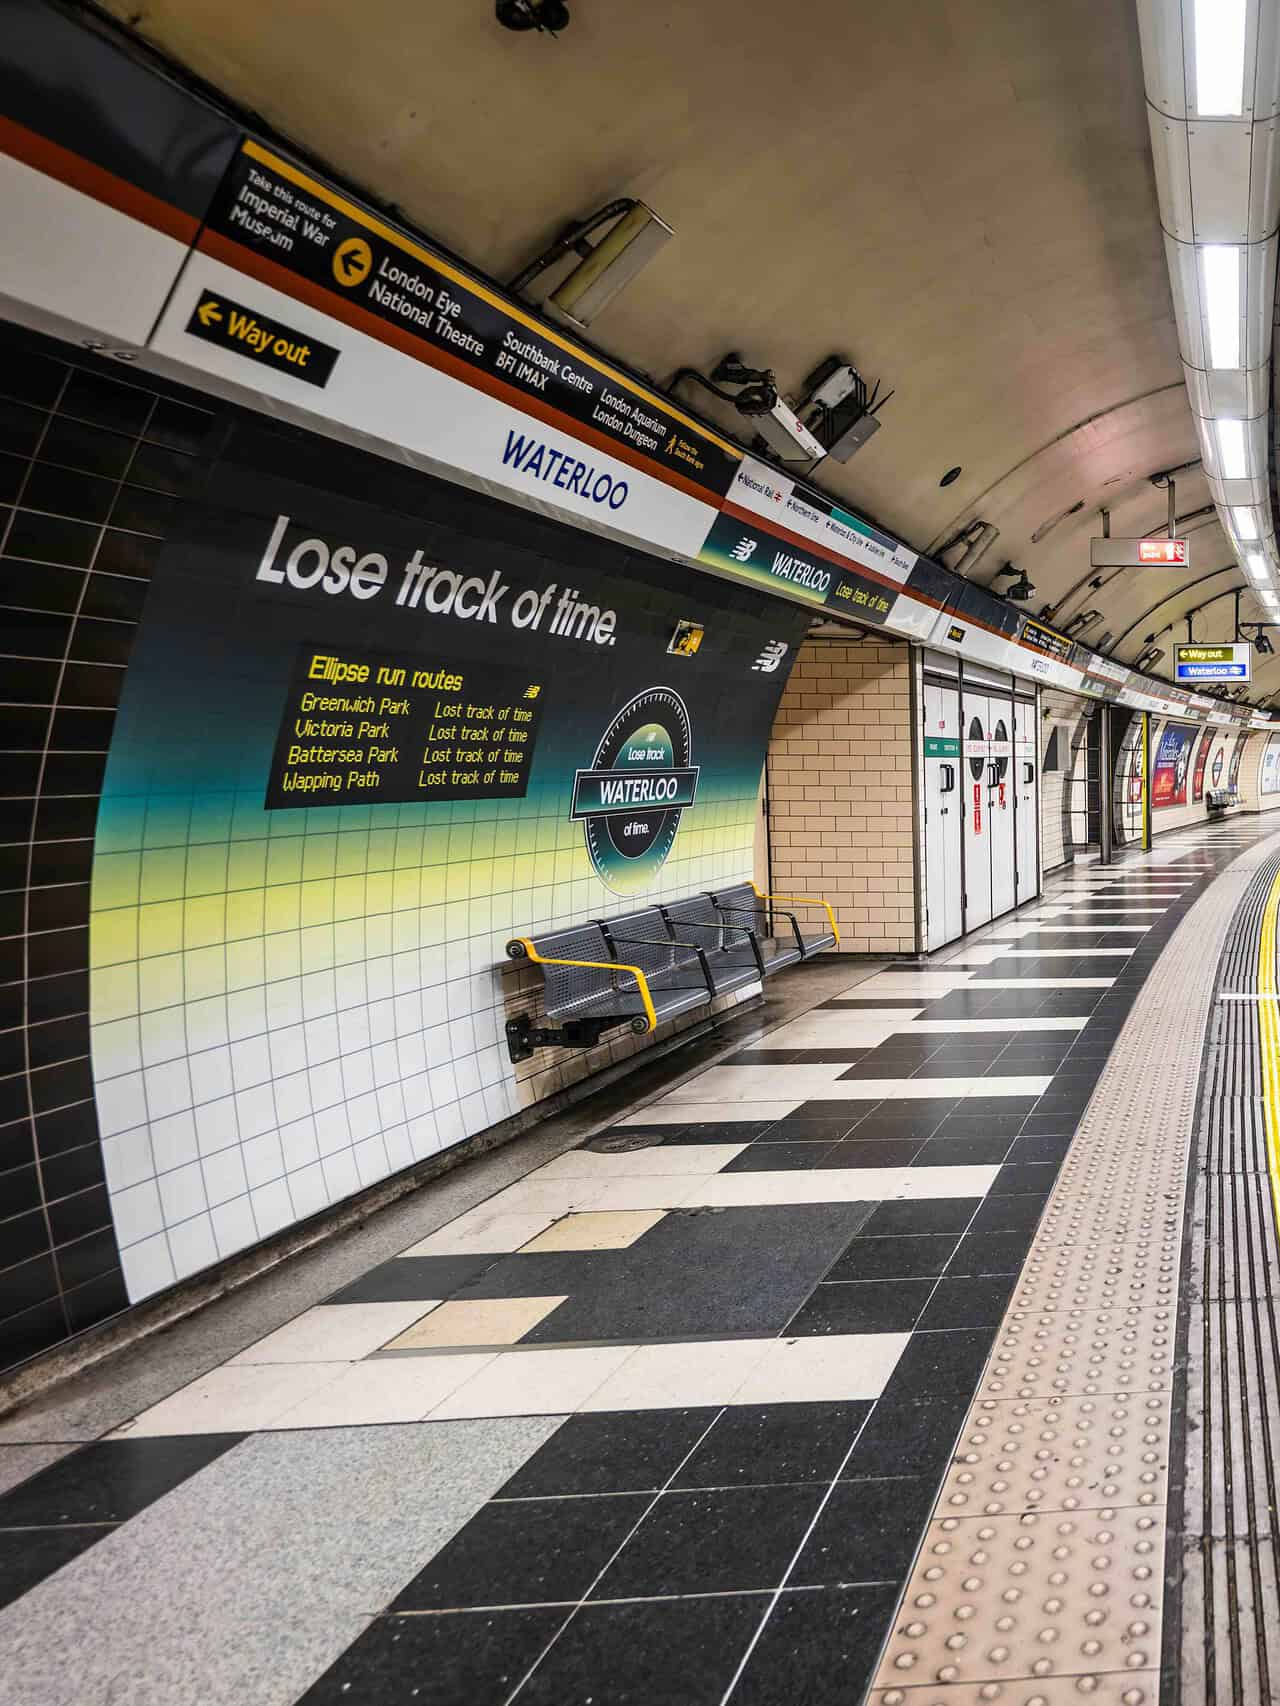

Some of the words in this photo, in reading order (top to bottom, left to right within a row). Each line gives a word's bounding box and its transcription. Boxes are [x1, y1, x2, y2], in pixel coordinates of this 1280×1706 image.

[238, 185, 298, 231] Imperial
[302, 220, 330, 247] War
[248, 169, 272, 192] Take
[274, 185, 294, 204] this
[294, 196, 321, 222] route
[322, 213, 337, 230] for
[230, 205, 294, 251] Museum
[378, 256, 435, 303] London
[435, 290, 462, 319] Eye
[368, 280, 433, 329] National
[434, 316, 485, 357] Theatre
[227, 310, 274, 353] Way
[273, 337, 311, 367] out
[496, 351, 516, 374] BFI
[516, 361, 550, 392] IMAX
[503, 331, 561, 375] Southbank
[560, 366, 594, 395] Centre
[592, 404, 629, 435] London
[624, 423, 658, 452] Dungeon
[600, 388, 632, 418] London
[631, 406, 667, 438] Aquarium
[501, 429, 629, 510] WATERLOO
[255, 515, 389, 600] Lose
[395, 549, 509, 624] track
[511, 583, 558, 631] of
[549, 589, 617, 646] time.
[770, 551, 831, 592] WATERLOO
[1188, 649, 1206, 660] Way
[1207, 649, 1223, 659] out
[1188, 665, 1227, 675] Waterloo
[308, 655, 370, 686] Ellipse
[376, 665, 406, 687] run
[411, 668, 463, 692] routes
[301, 692, 375, 713] Greenwich
[379, 698, 410, 716] Park
[434, 701, 462, 719] Lost
[466, 703, 495, 720] track
[497, 707, 511, 721] of
[513, 708, 533, 723] time
[295, 719, 354, 738] Victoria
[357, 721, 390, 739] Park
[428, 724, 456, 742] Lost
[461, 725, 489, 742] track
[492, 727, 506, 743] of
[508, 728, 528, 744] time
[287, 746, 364, 765] Battersea
[367, 746, 399, 765] Park
[423, 747, 451, 764] Lost
[456, 747, 484, 764] track
[487, 749, 501, 764] of
[504, 749, 525, 764] time
[628, 747, 645, 761] Lose
[646, 747, 664, 761] track
[283, 771, 342, 793] Wapping
[346, 771, 380, 790] Path
[418, 770, 447, 788] Lost
[451, 770, 480, 785] track
[483, 770, 496, 784] of
[499, 770, 519, 784] time
[600, 777, 678, 806] WATERLOO
[624, 822, 634, 837] of
